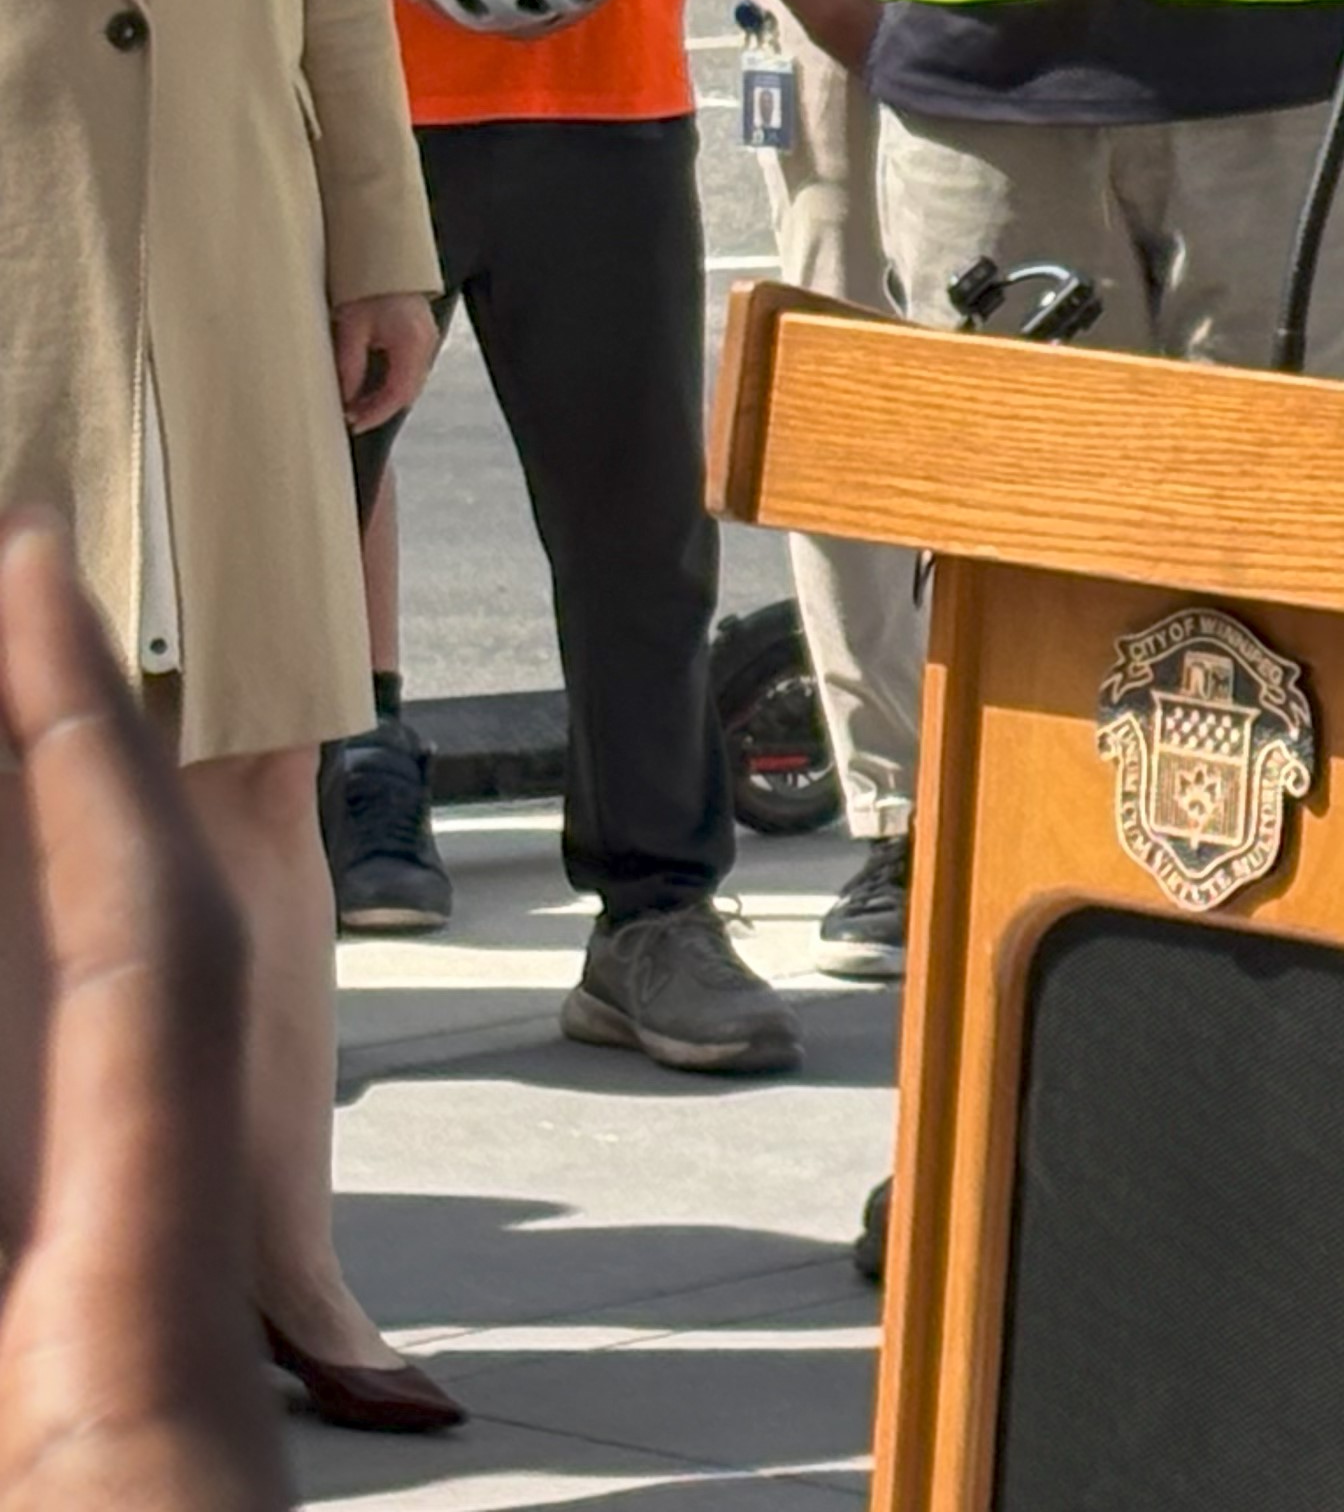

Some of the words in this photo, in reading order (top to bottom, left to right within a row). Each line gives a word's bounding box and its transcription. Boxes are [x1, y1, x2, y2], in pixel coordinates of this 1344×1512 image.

[1129, 628, 1168, 661] CITY
[1168, 617, 1195, 641] OF
[1200, 616, 1284, 686] WINNIPEG
